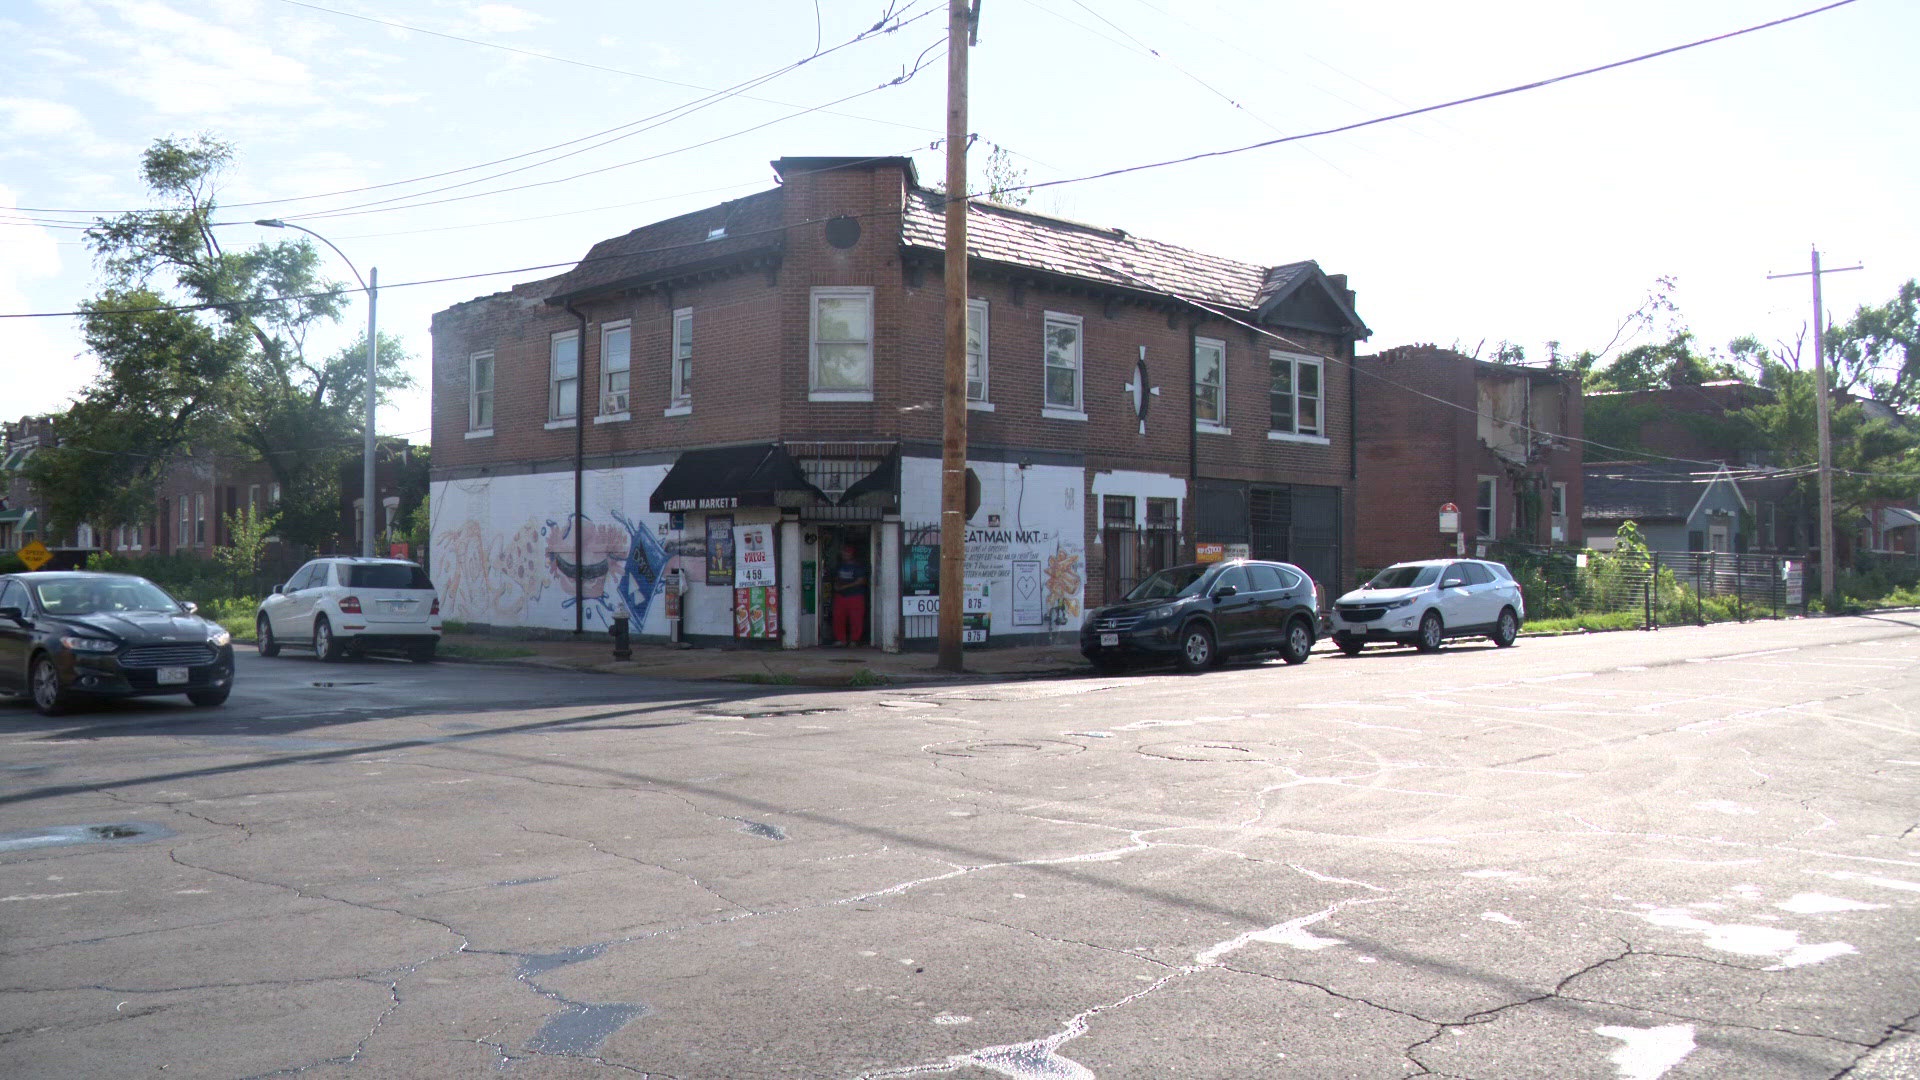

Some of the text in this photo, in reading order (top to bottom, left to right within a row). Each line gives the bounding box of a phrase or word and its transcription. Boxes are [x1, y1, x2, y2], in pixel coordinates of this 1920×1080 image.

[663, 499, 696, 510] YEATMAN
[699, 498, 729, 509] MARKET
[965, 530, 1012, 543] EATMAN
[744, 555, 766, 563] VALUE
